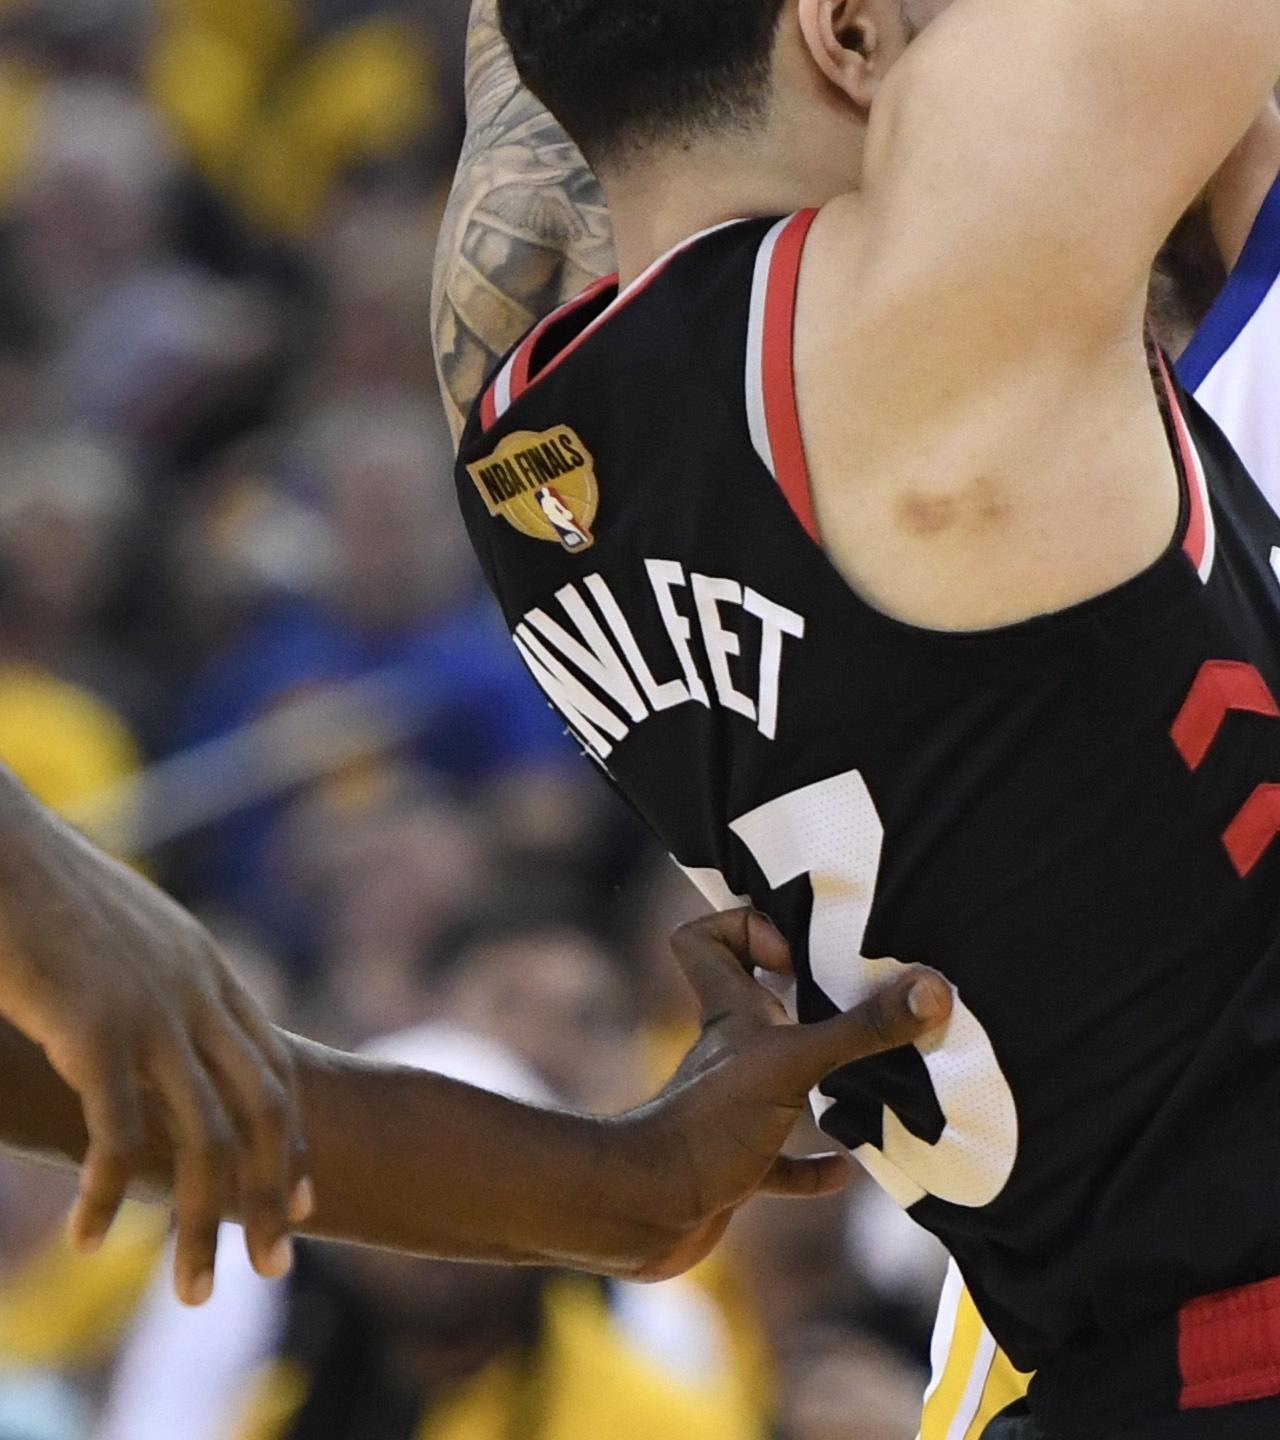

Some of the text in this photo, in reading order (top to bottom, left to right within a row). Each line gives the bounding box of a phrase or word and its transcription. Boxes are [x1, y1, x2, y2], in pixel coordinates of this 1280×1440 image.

[477, 433, 586, 506] NBA FINALS
[511, 557, 806, 761] NVLEET
[669, 768, 1019, 1211] 3
